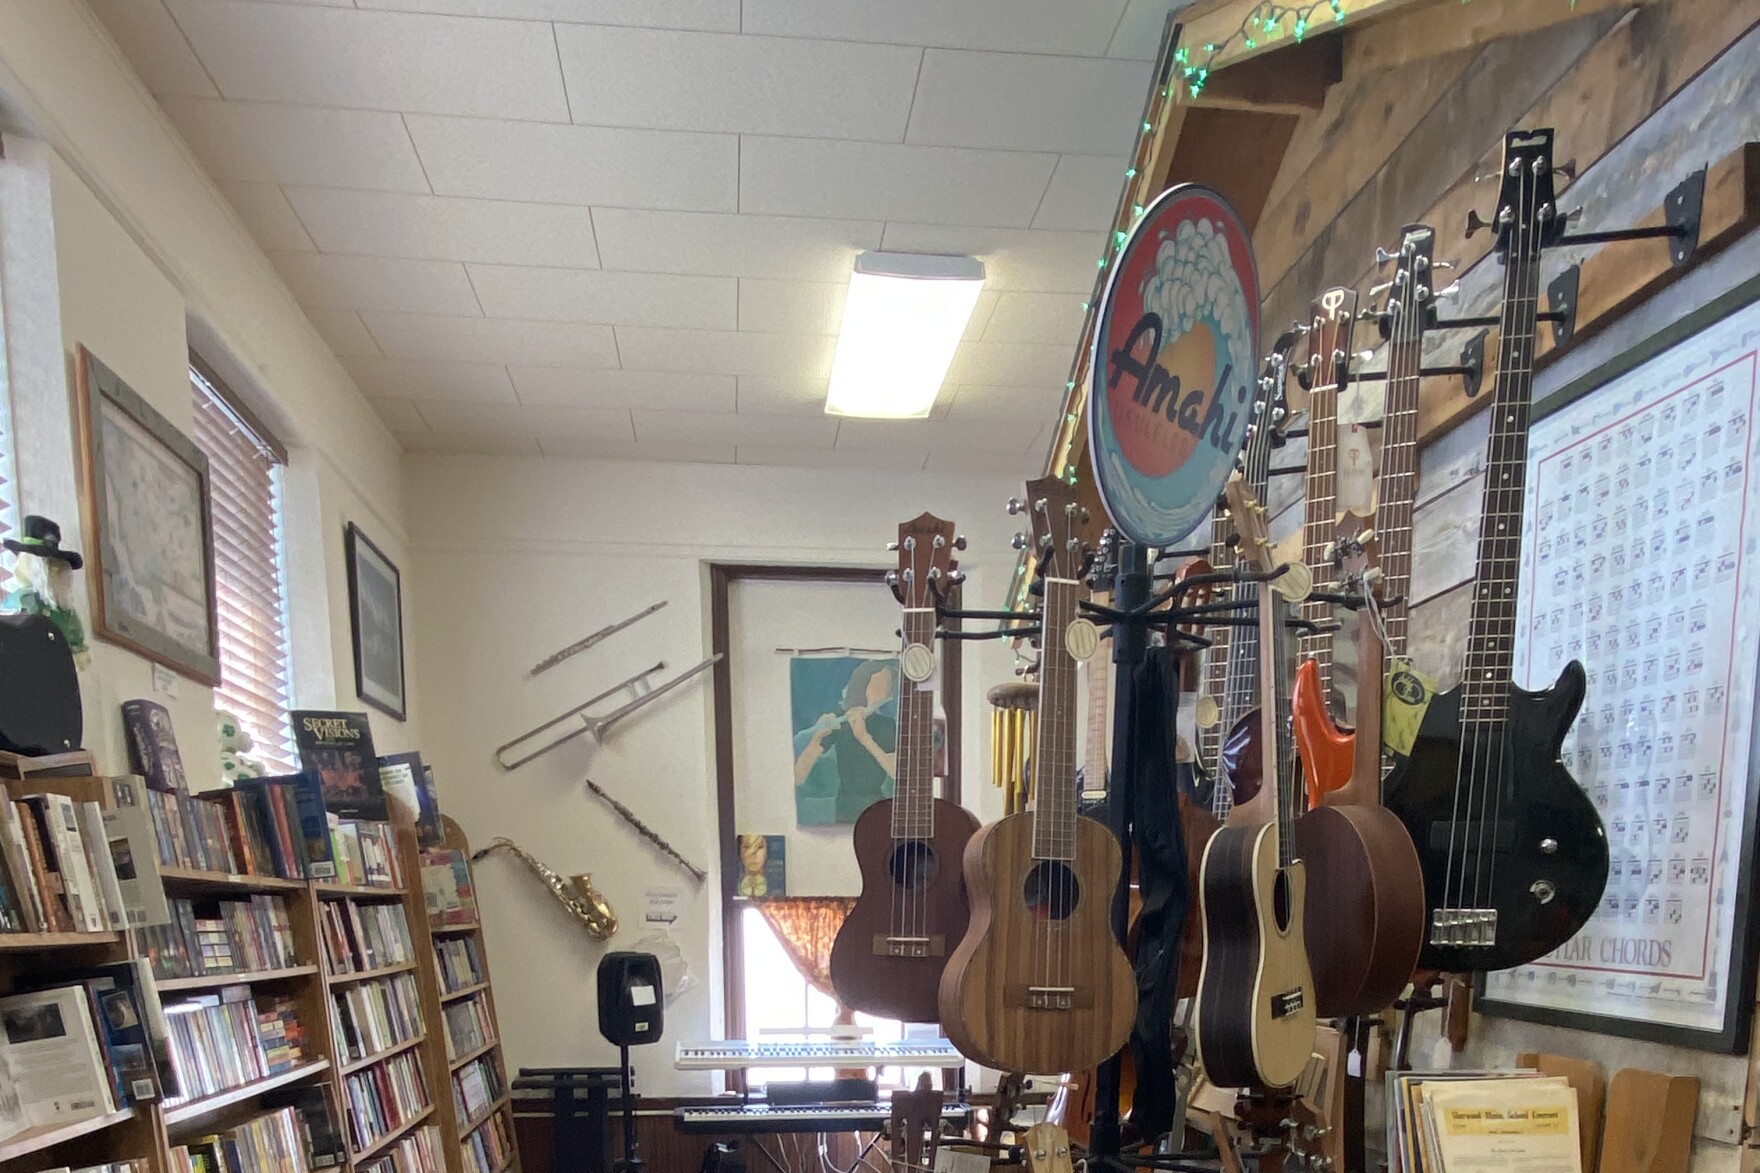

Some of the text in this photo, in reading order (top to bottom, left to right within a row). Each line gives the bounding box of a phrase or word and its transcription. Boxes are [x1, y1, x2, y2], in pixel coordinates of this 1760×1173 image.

[1110, 312, 1248, 455] Amahi
[303, 717, 347, 731] SECRET
[313, 727, 360, 740] VISIONS
[1601, 938, 1672, 967] CHORDS
